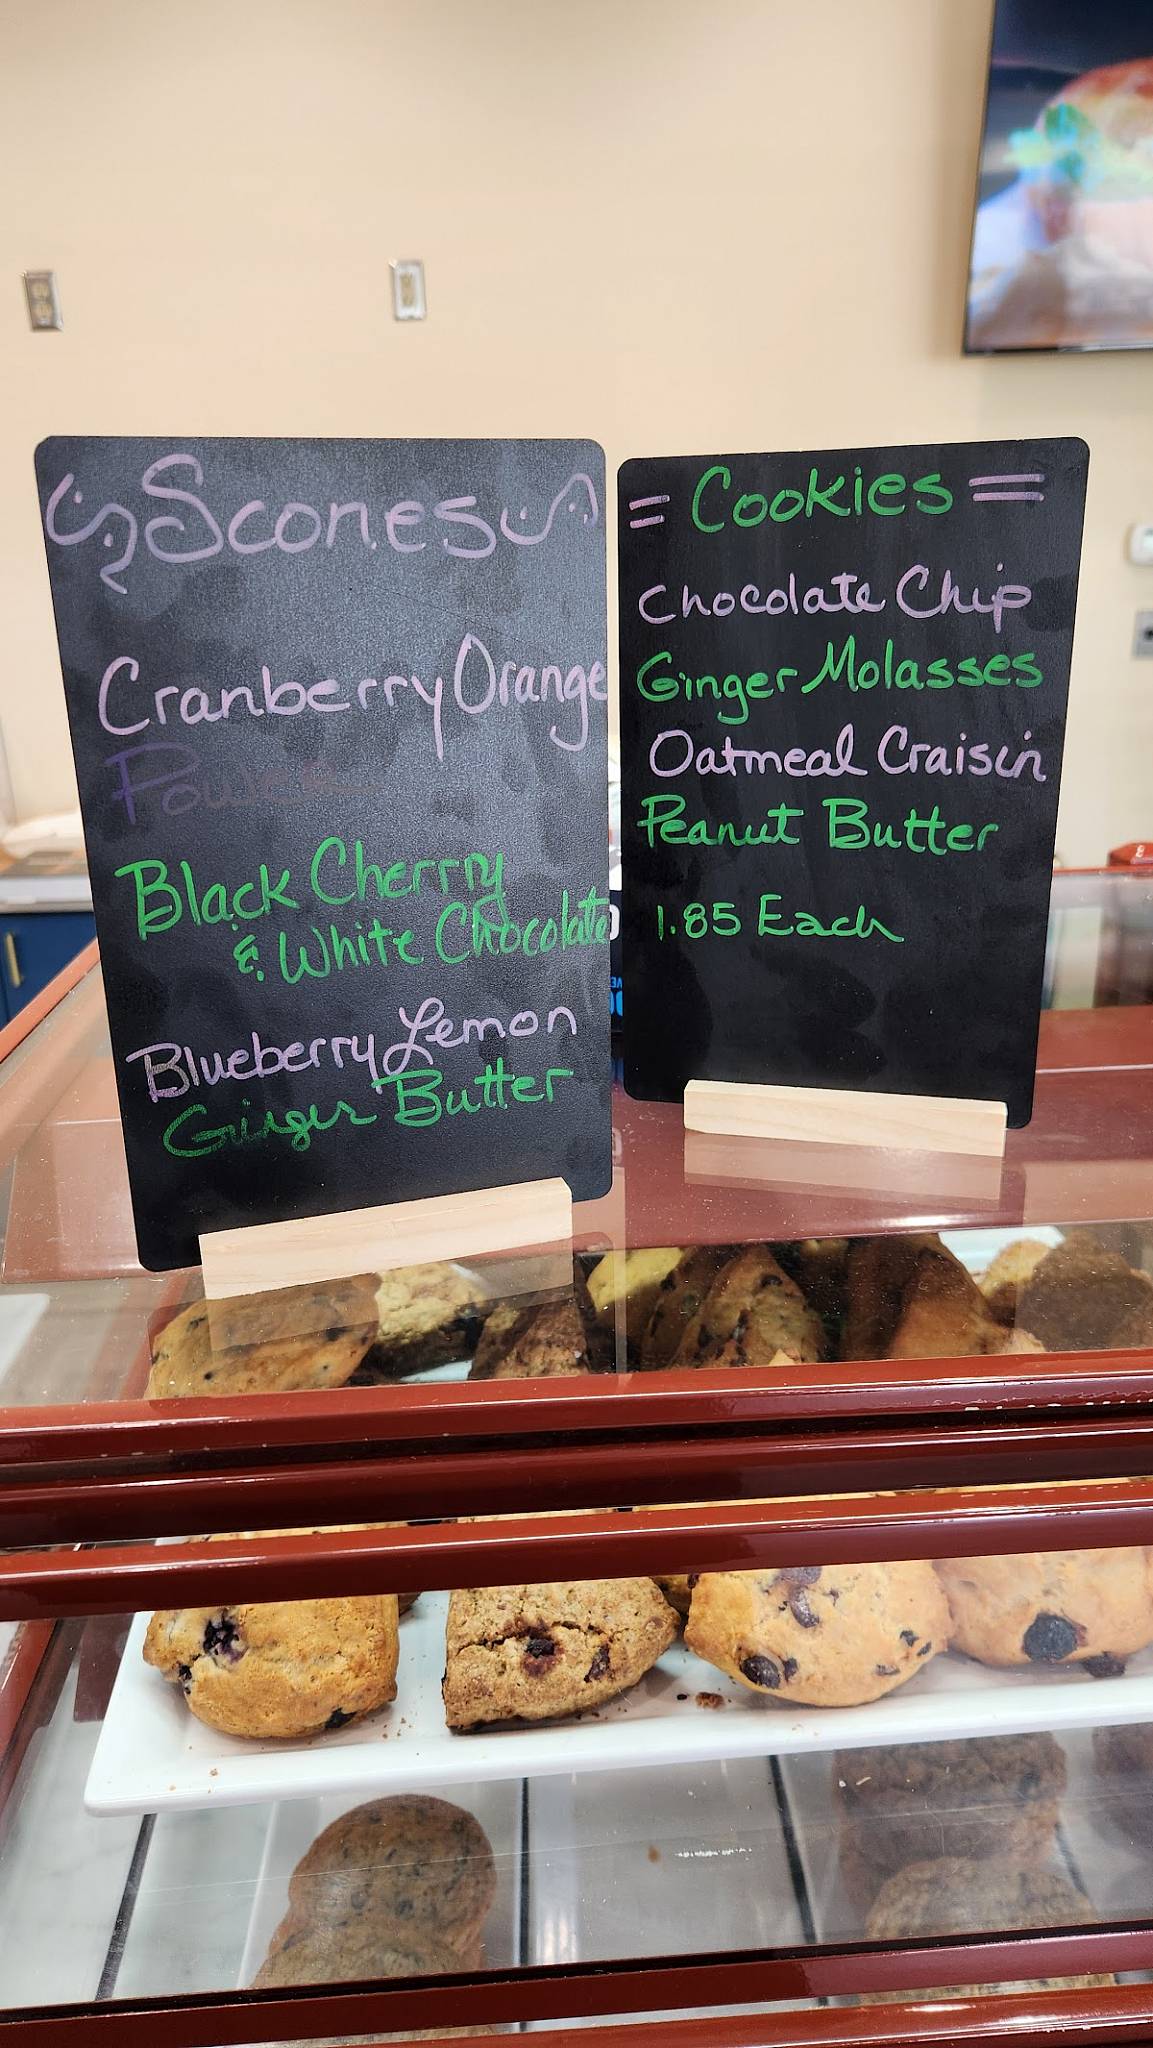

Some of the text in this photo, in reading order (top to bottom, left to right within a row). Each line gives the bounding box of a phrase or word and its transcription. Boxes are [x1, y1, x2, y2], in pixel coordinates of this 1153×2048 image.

[141, 453, 497, 564] Scones
[692, 466, 954, 534] Cookies
[638, 563, 1032, 634] Chocolate Chip
[97, 633, 607, 759] Cranberry Orange
[637, 635, 1044, 725] Ginger Molasses
[649, 723, 1046, 782] Oatmeal Craisin
[637, 795, 1000, 855] Peanut Butter
[114, 859, 300, 940] Black
[279, 918, 424, 984] White
[435, 885, 610, 965] Chocolate
[657, 903, 741, 941] 1.85
[757, 894, 905, 943] Each
[126, 997, 578, 1103] Blueberry Lemon
[162, 1057, 574, 1157] Ginger Butter
